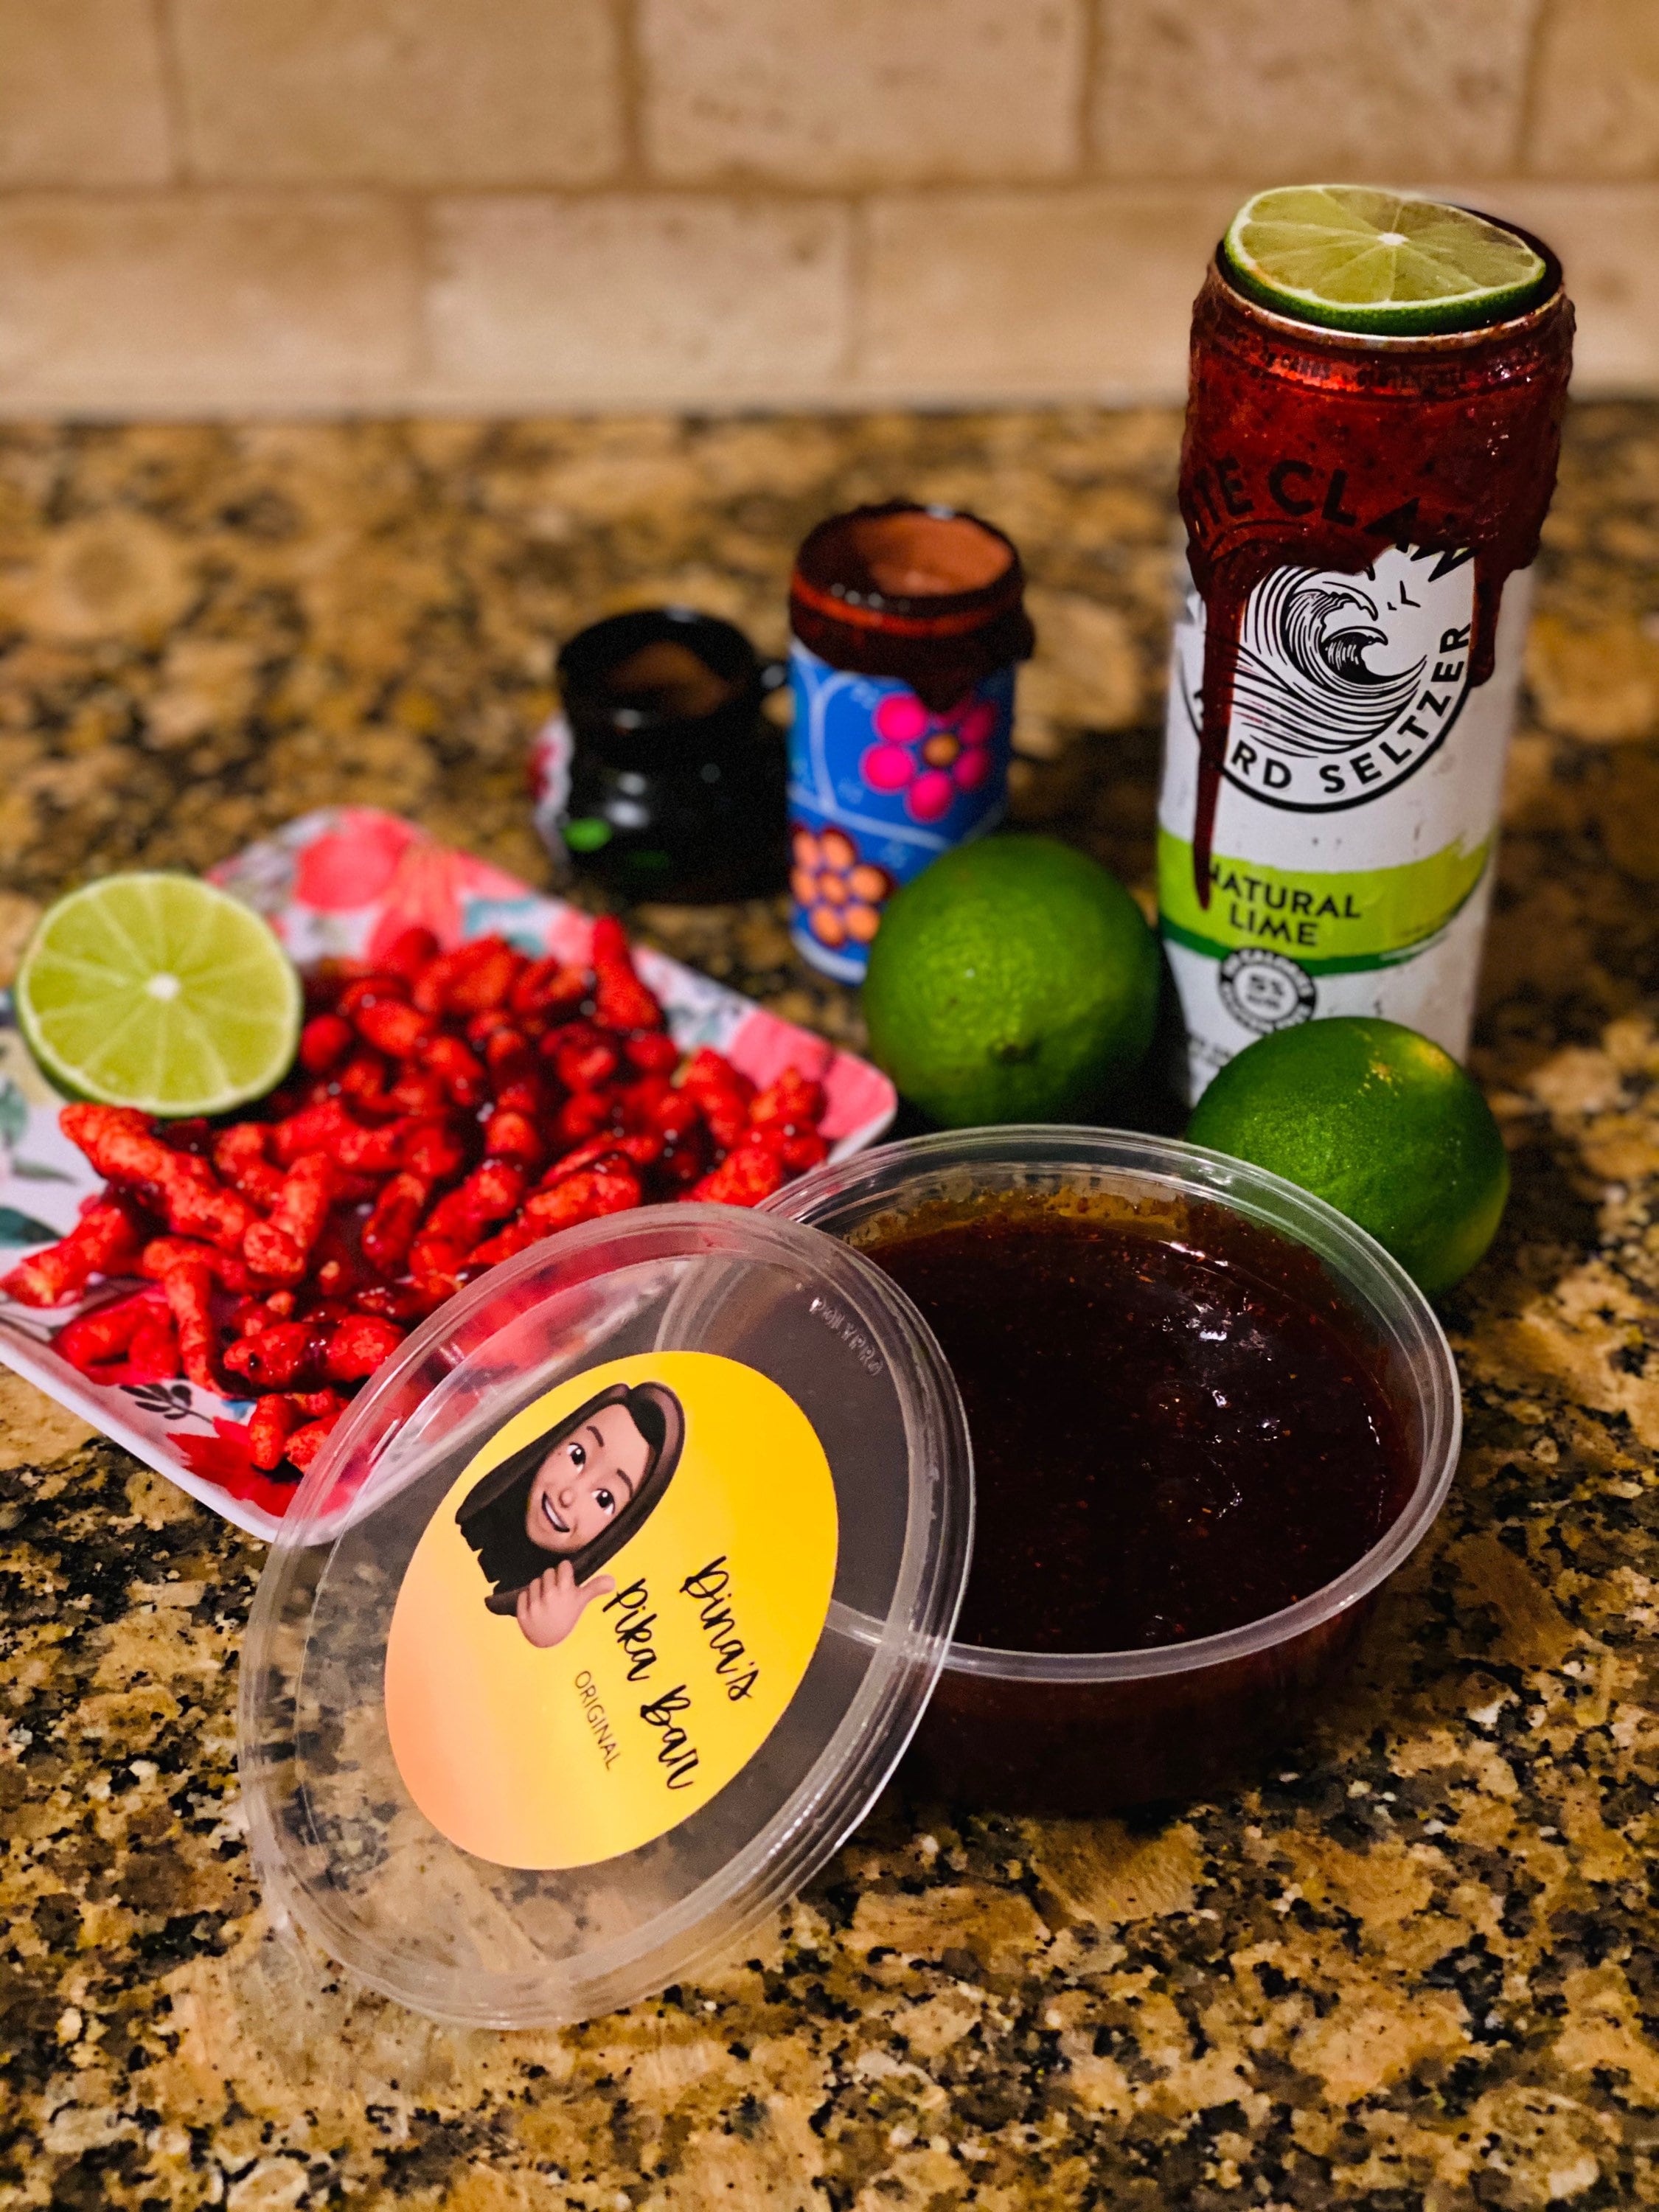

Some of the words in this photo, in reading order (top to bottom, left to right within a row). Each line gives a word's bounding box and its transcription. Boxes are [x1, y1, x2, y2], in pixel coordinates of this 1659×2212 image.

[1318, 623, 1471, 794] SELTZER
[1229, 903, 1318, 946] LIME
[602, 1578, 658, 1681] Pika
[680, 1555, 759, 1701] Dina's
[574, 1670, 622, 1771] ORIGINAL
